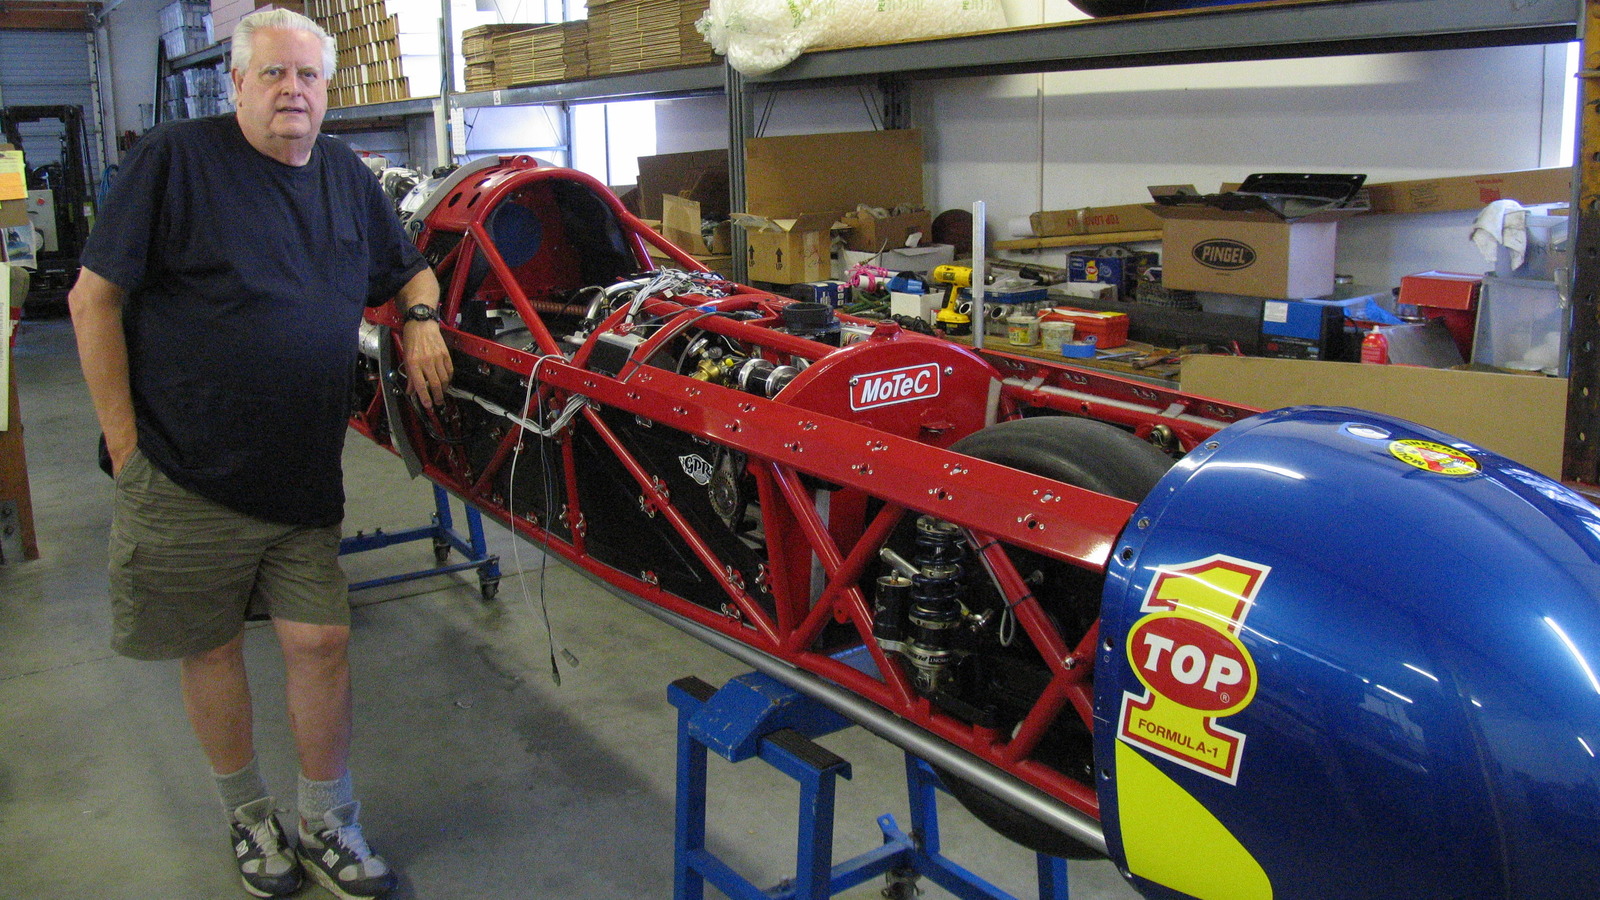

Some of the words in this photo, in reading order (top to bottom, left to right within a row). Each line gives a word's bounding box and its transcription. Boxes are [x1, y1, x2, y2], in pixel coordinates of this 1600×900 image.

[775, 262, 783, 271] UP
[1202, 245, 1246, 264] PINGEL
[860, 369, 931, 404] MoTeC
[684, 456, 713, 478] GPR
[1143, 632, 1244, 693] TOP
[1137, 718, 1218, 758] FORMULA-1
